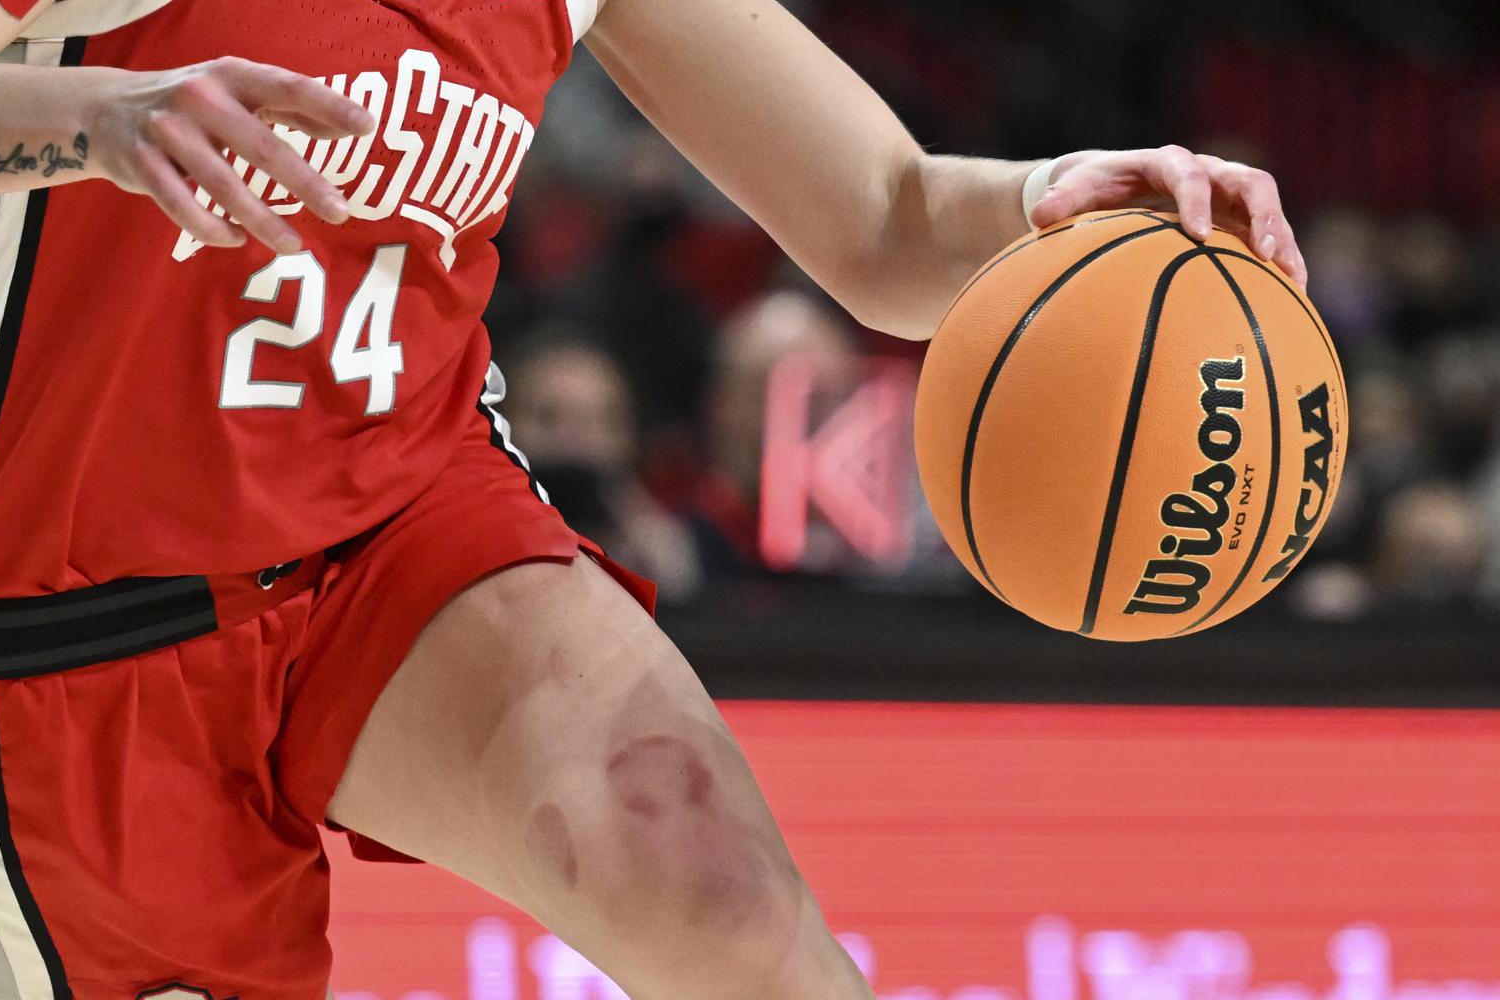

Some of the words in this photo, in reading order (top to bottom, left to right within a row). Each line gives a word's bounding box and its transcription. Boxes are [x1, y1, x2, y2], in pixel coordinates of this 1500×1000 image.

[218, 243, 408, 416] 24
[1122, 356, 1246, 615] Wilson
[1228, 512, 1247, 551] EVO
[1239, 464, 1256, 507] NXT
[1261, 382, 1334, 583] NCAA
